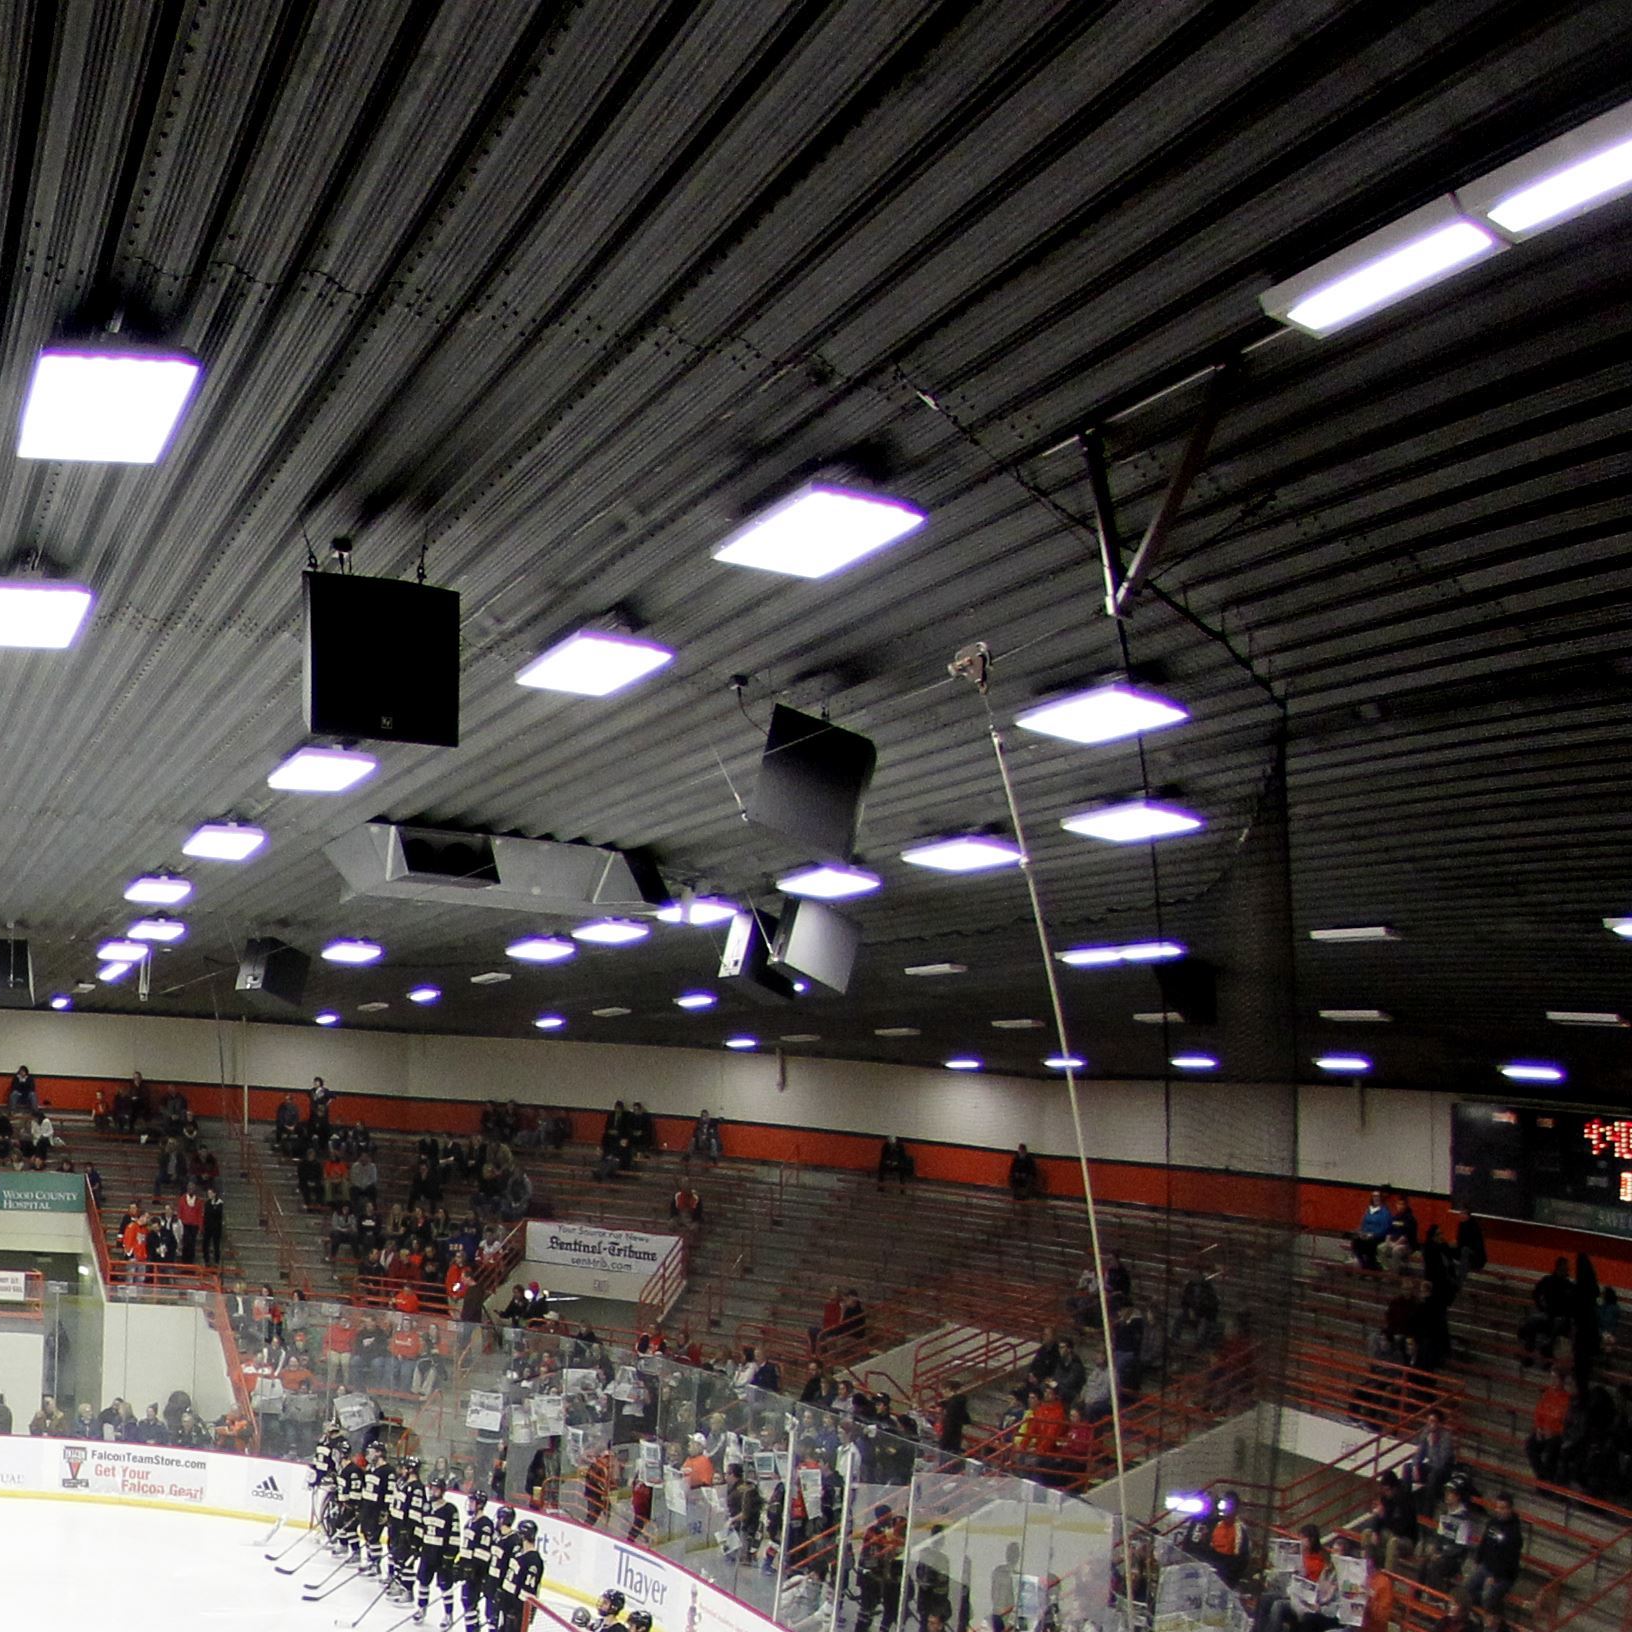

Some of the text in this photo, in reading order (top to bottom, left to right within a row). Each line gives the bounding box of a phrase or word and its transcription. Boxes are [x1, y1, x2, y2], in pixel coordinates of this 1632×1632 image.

[35, 1190, 78, 1201] COUNTY
[3, 1200, 51, 1210] HOSPITAL
[547, 1235, 657, 1261] Sentinel-Tribune
[91, 1450, 206, 1470] FalconTeamStore.com
[94, 1464, 151, 1481] Get Your
[121, 1480, 204, 1500] Falcon Gear!
[251, 1489, 284, 1500] adidas
[615, 1545, 667, 1605] Thayer
